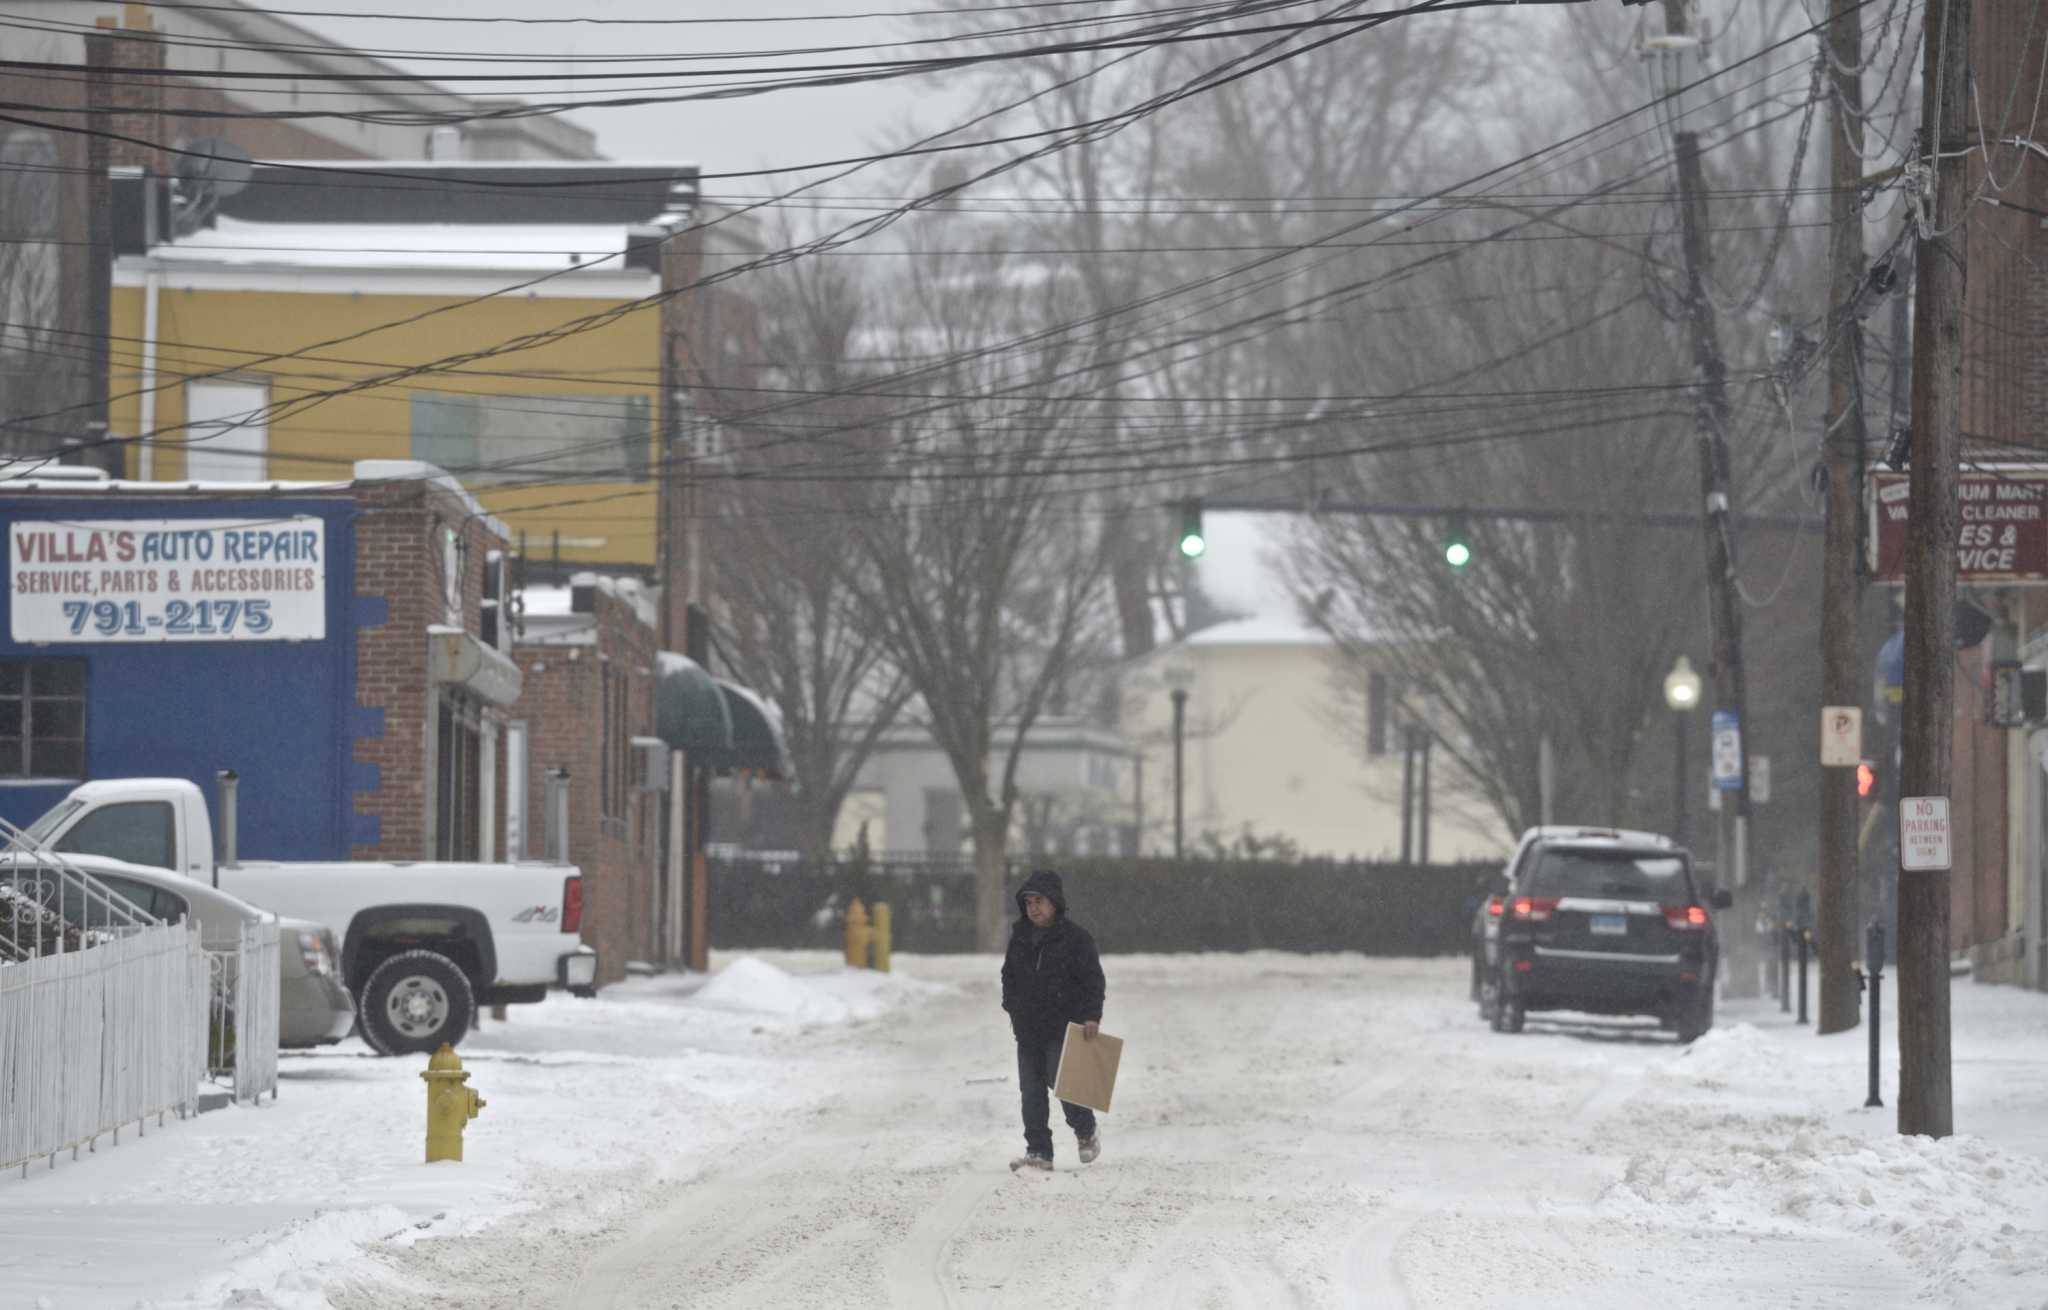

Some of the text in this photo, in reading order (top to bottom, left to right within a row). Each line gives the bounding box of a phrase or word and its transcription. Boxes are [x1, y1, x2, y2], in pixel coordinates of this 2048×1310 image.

[1996, 483, 2046, 500] MART
[1961, 504, 2040, 521] CLEANER
[1959, 524, 2017, 546] ES &
[16, 530, 319, 563] VILLA'S AUTO REPAIR
[1956, 548, 2016, 571] VICE
[167, 569, 181, 592] &
[191, 568, 315, 592] ACCESSORIES
[63, 599, 272, 635] 791-2175
[1916, 802, 1934, 816] NO
[1904, 819, 1945, 833] PARKING
